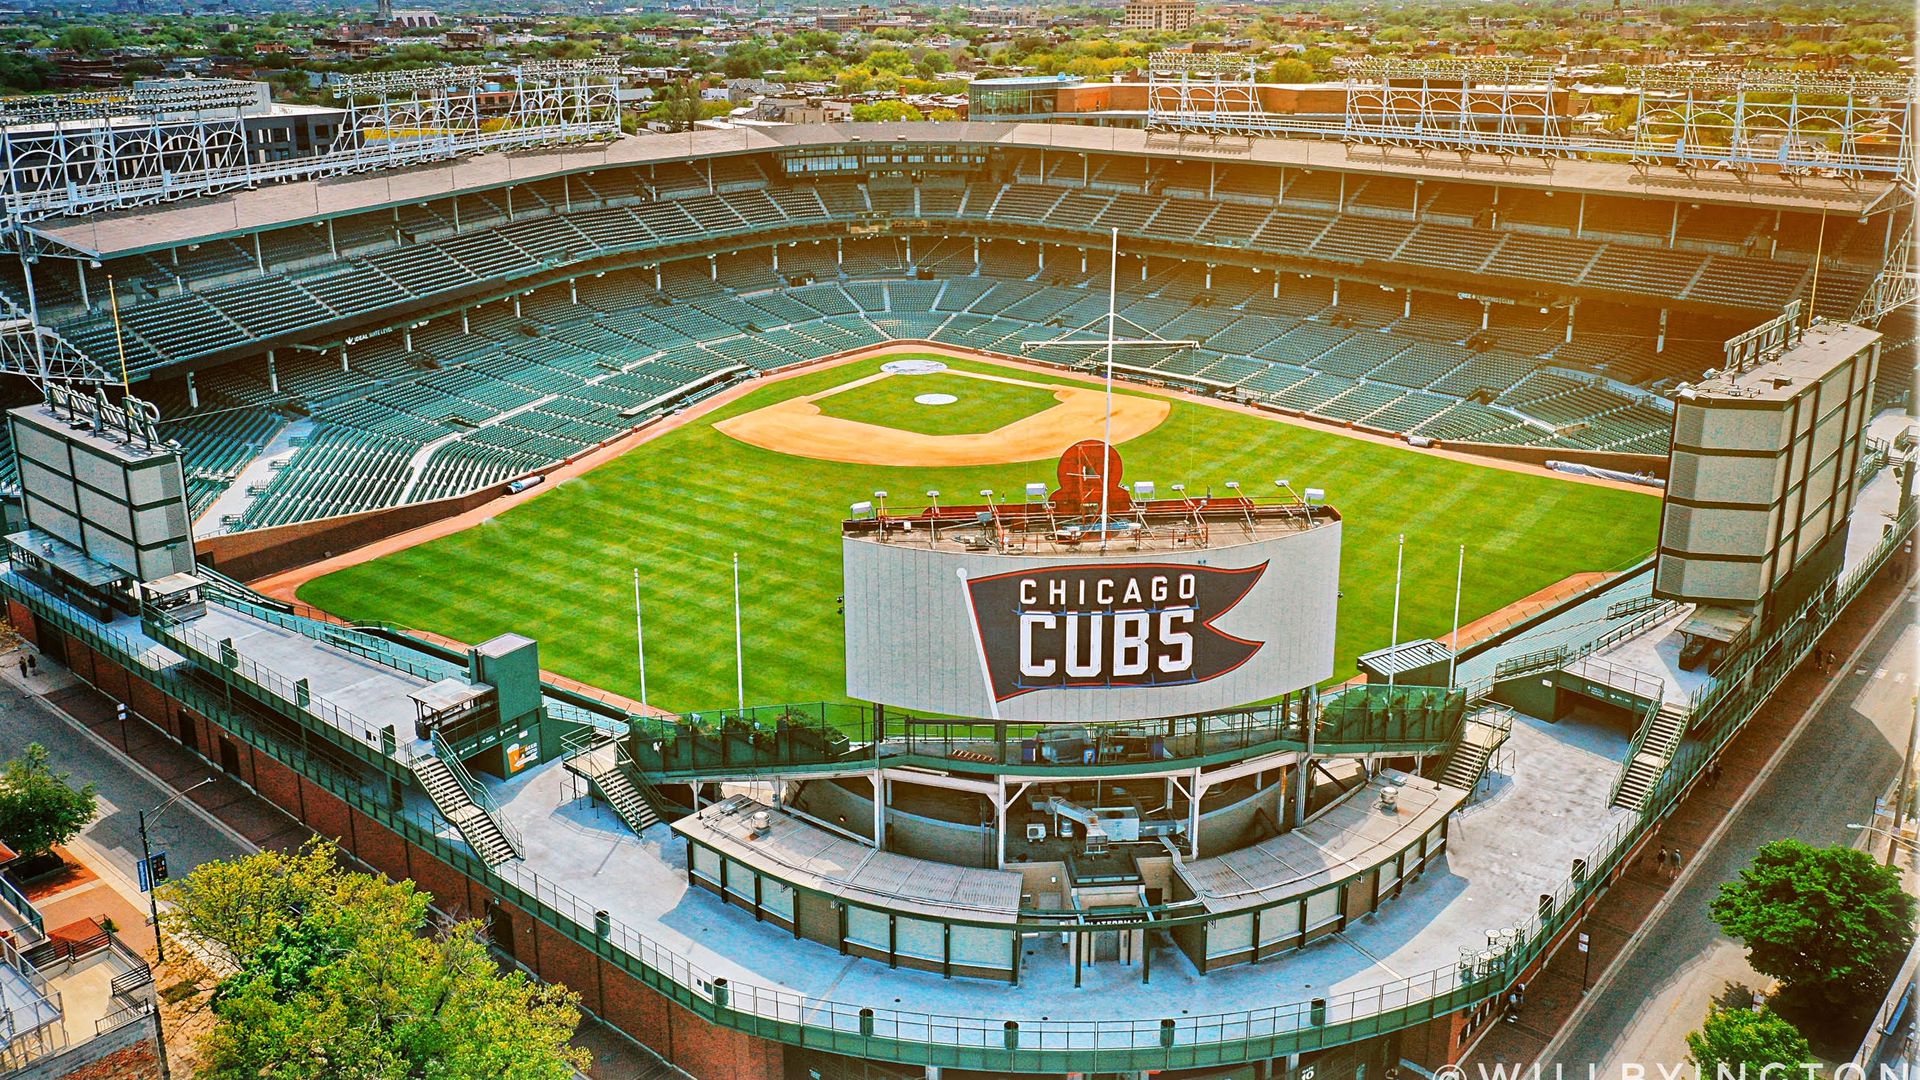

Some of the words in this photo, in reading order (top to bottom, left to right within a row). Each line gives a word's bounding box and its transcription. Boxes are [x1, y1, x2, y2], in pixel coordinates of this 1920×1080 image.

[1019, 573, 1196, 605] CHICAGO
[1019, 605, 1195, 678] CUBS
[1301, 1070, 1315, 1080] 10
